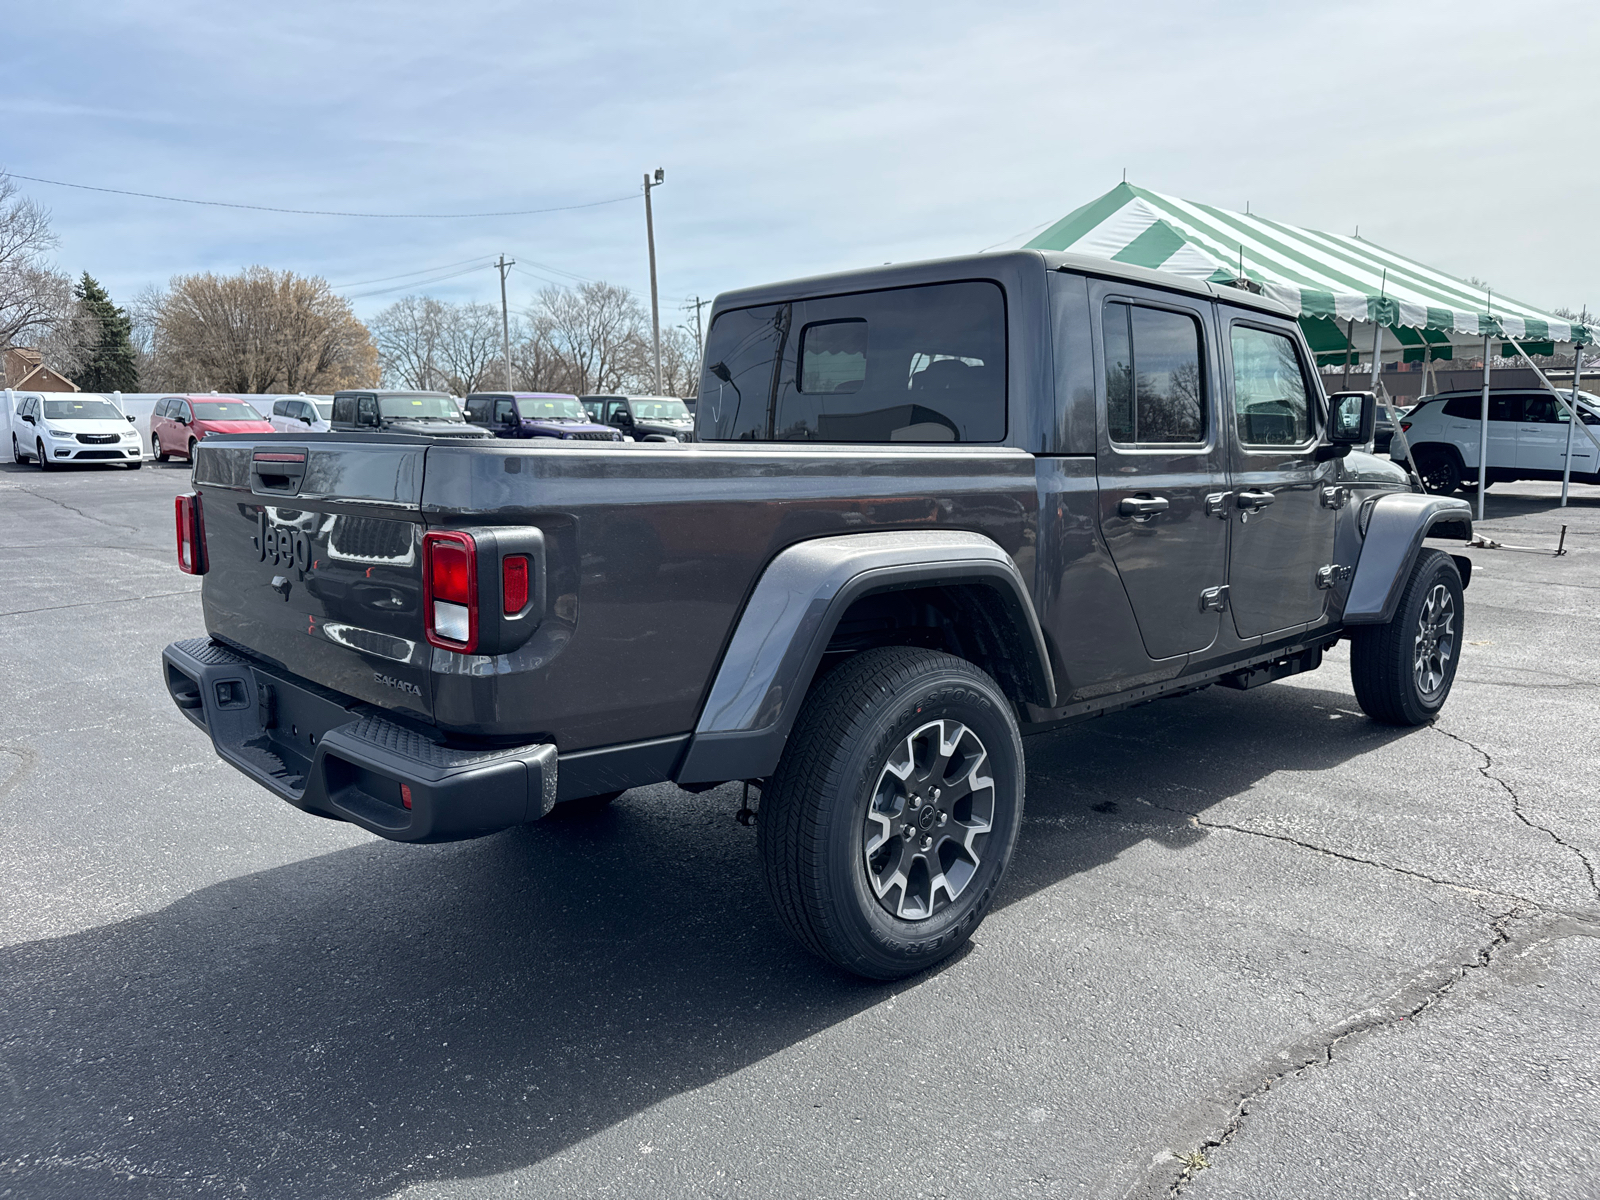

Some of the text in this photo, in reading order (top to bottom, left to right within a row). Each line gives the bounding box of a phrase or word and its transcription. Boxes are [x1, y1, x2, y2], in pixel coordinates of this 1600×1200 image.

[251, 511, 312, 582] Jeep
[373, 672, 422, 697] SAHARA
[854, 687, 991, 807] BRIDGESTONE
